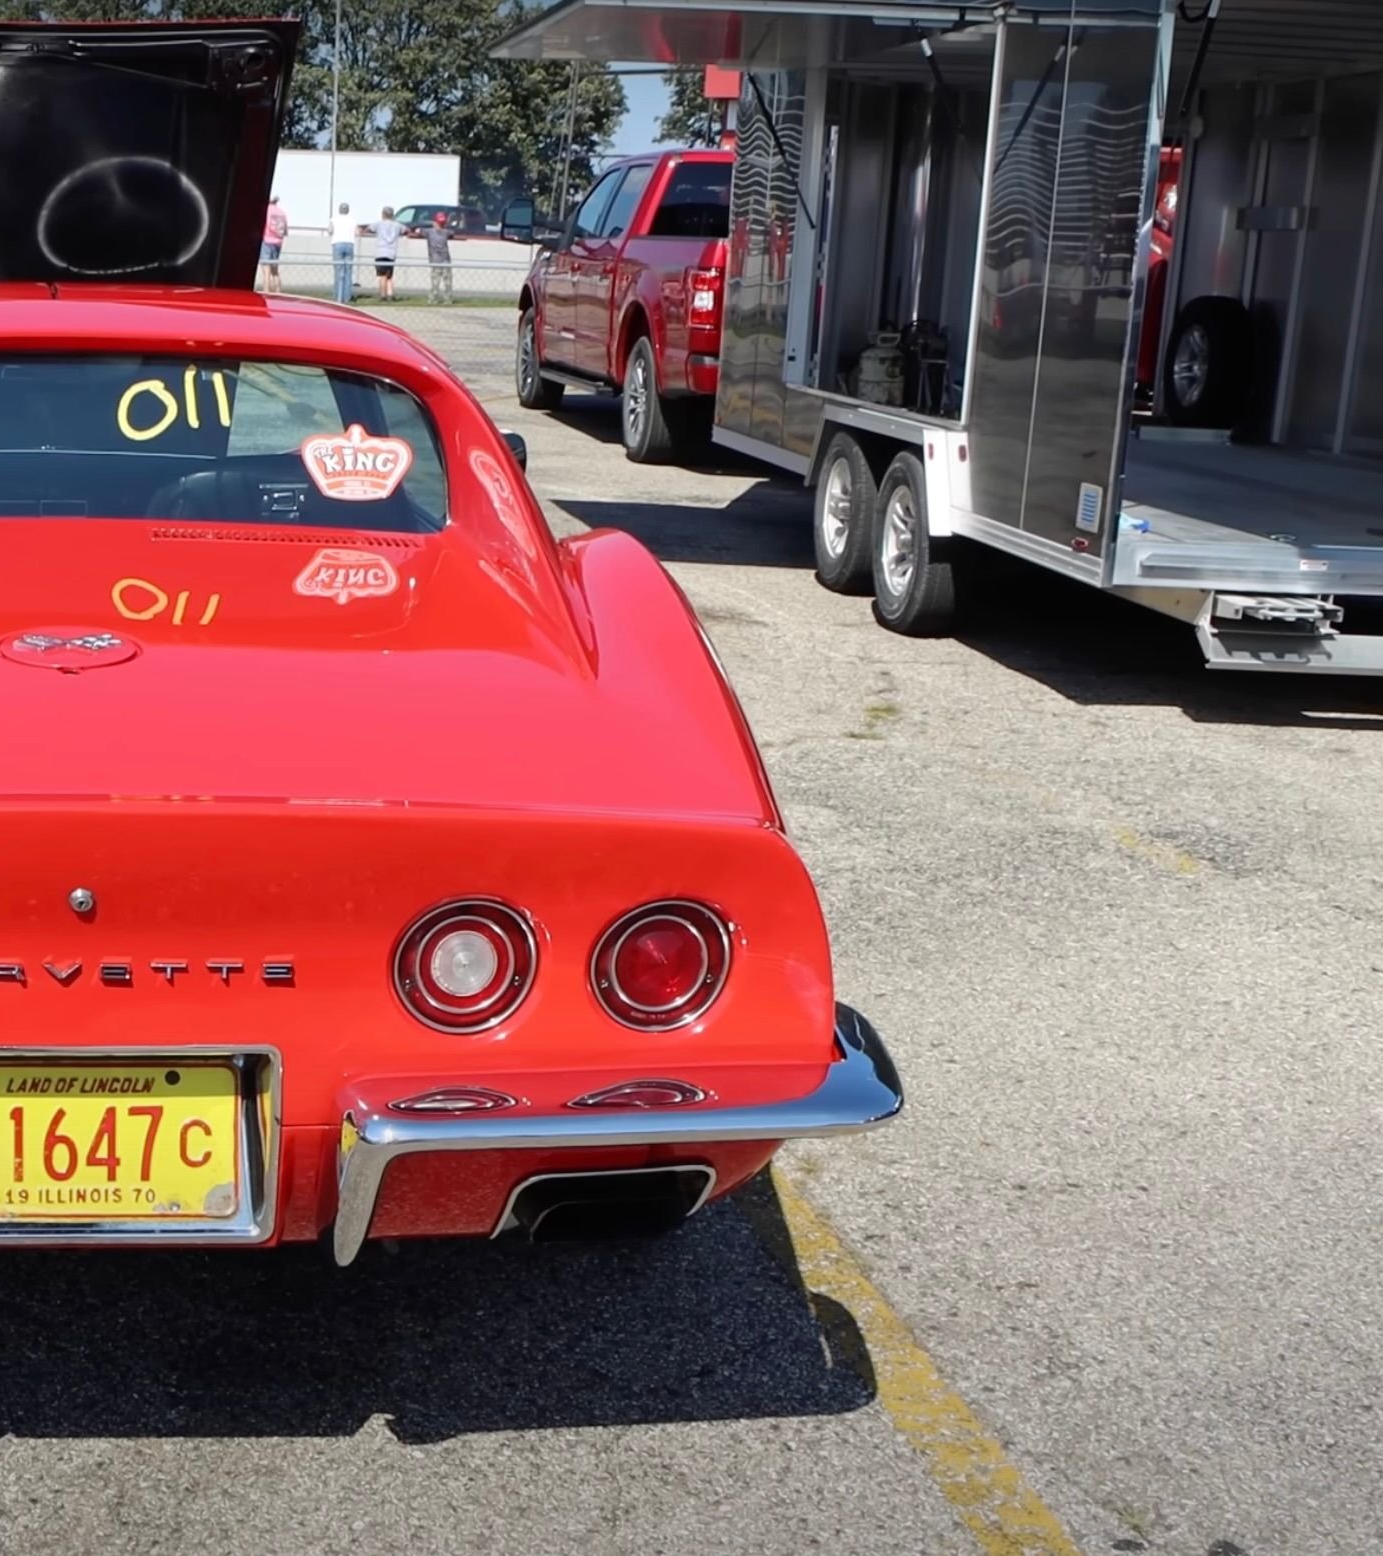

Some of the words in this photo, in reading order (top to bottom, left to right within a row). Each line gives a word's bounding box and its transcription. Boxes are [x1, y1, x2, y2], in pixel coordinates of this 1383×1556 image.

[118, 365, 231, 440] 011
[322, 447, 395, 473] KING
[6, 1078, 49, 1093] LAND
[54, 1077, 76, 1093] OF
[80, 1077, 154, 1093] LINCOLN
[10, 1106, 163, 1182] 1647
[179, 1120, 212, 1167] C
[6, 1189, 28, 1204] 19
[38, 1188, 122, 1204] ILLINOIS
[133, 1188, 156, 1204] 70
